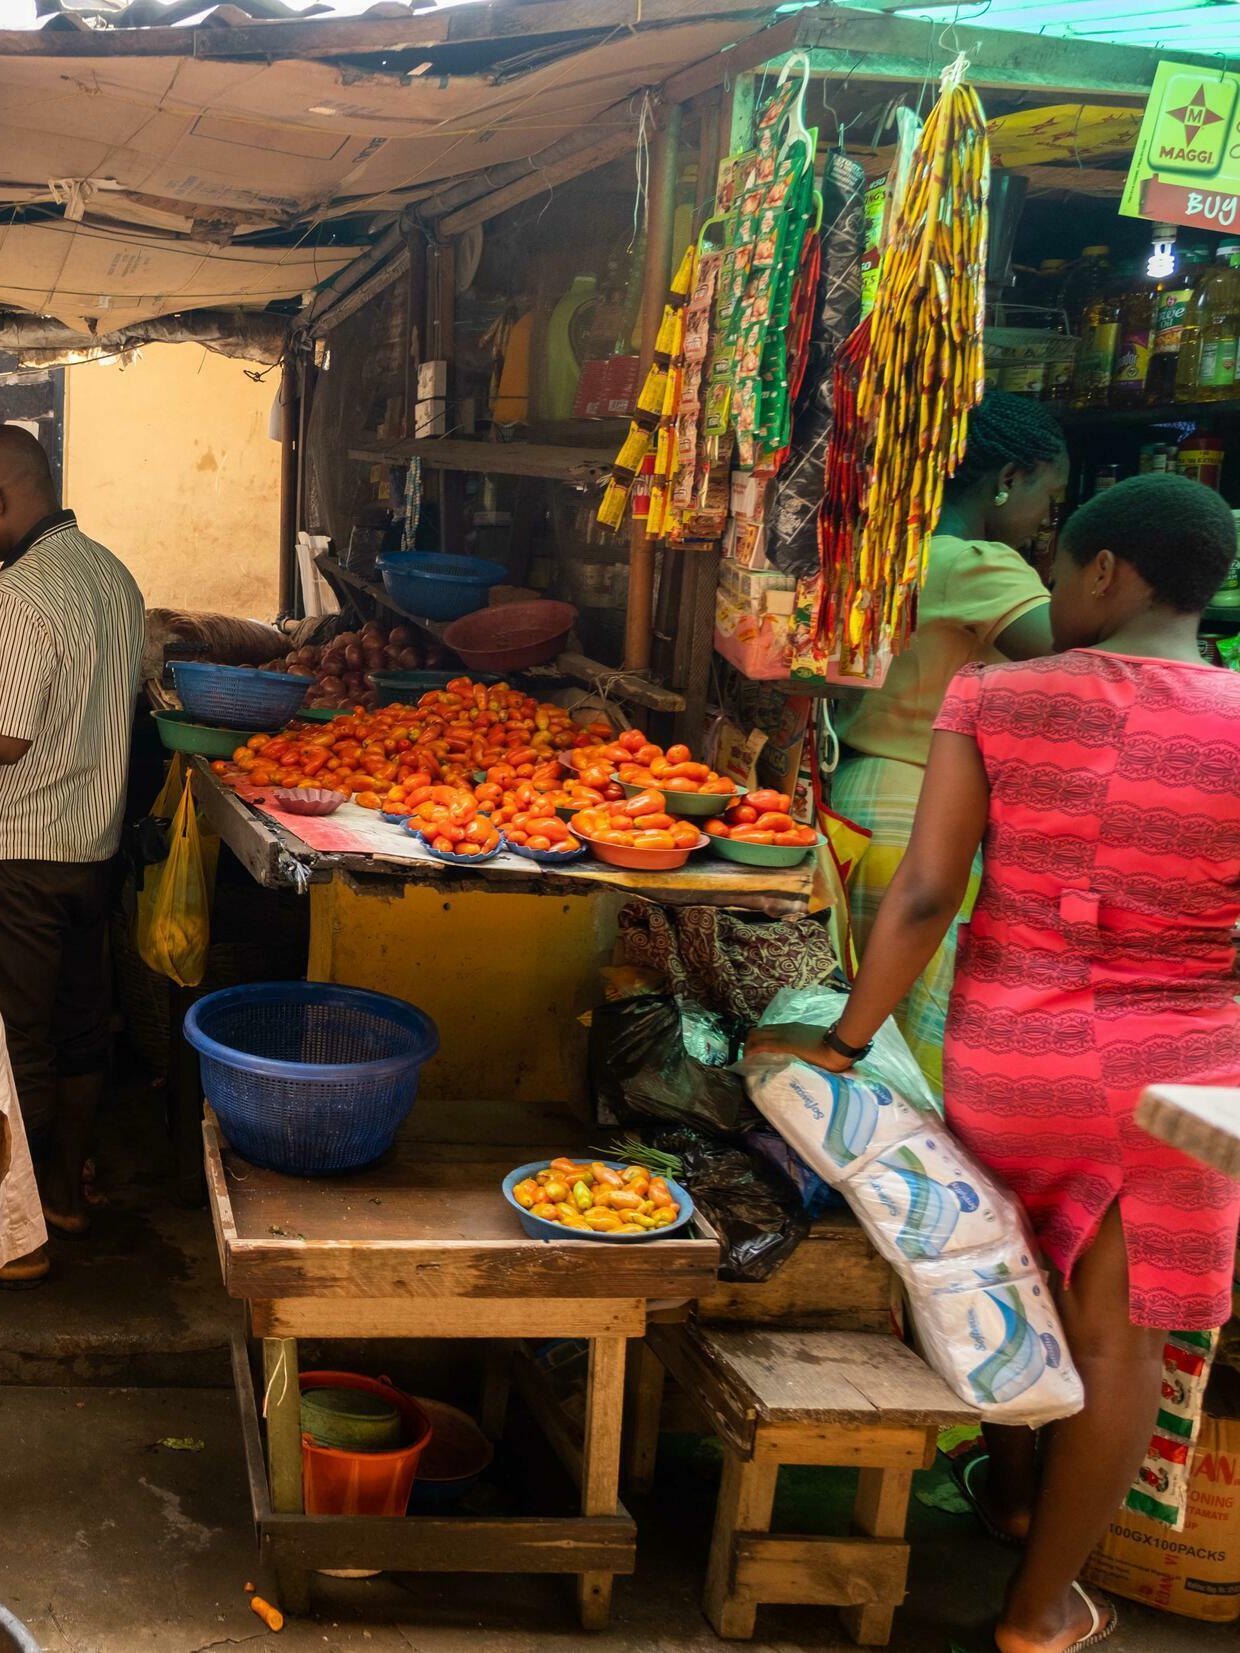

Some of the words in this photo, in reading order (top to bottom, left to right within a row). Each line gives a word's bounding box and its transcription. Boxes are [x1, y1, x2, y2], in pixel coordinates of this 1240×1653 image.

[1159, 145, 1213, 164] MAGGI
[1192, 1452, 1235, 1486] AN
[1190, 1490, 1234, 1508] ONING
